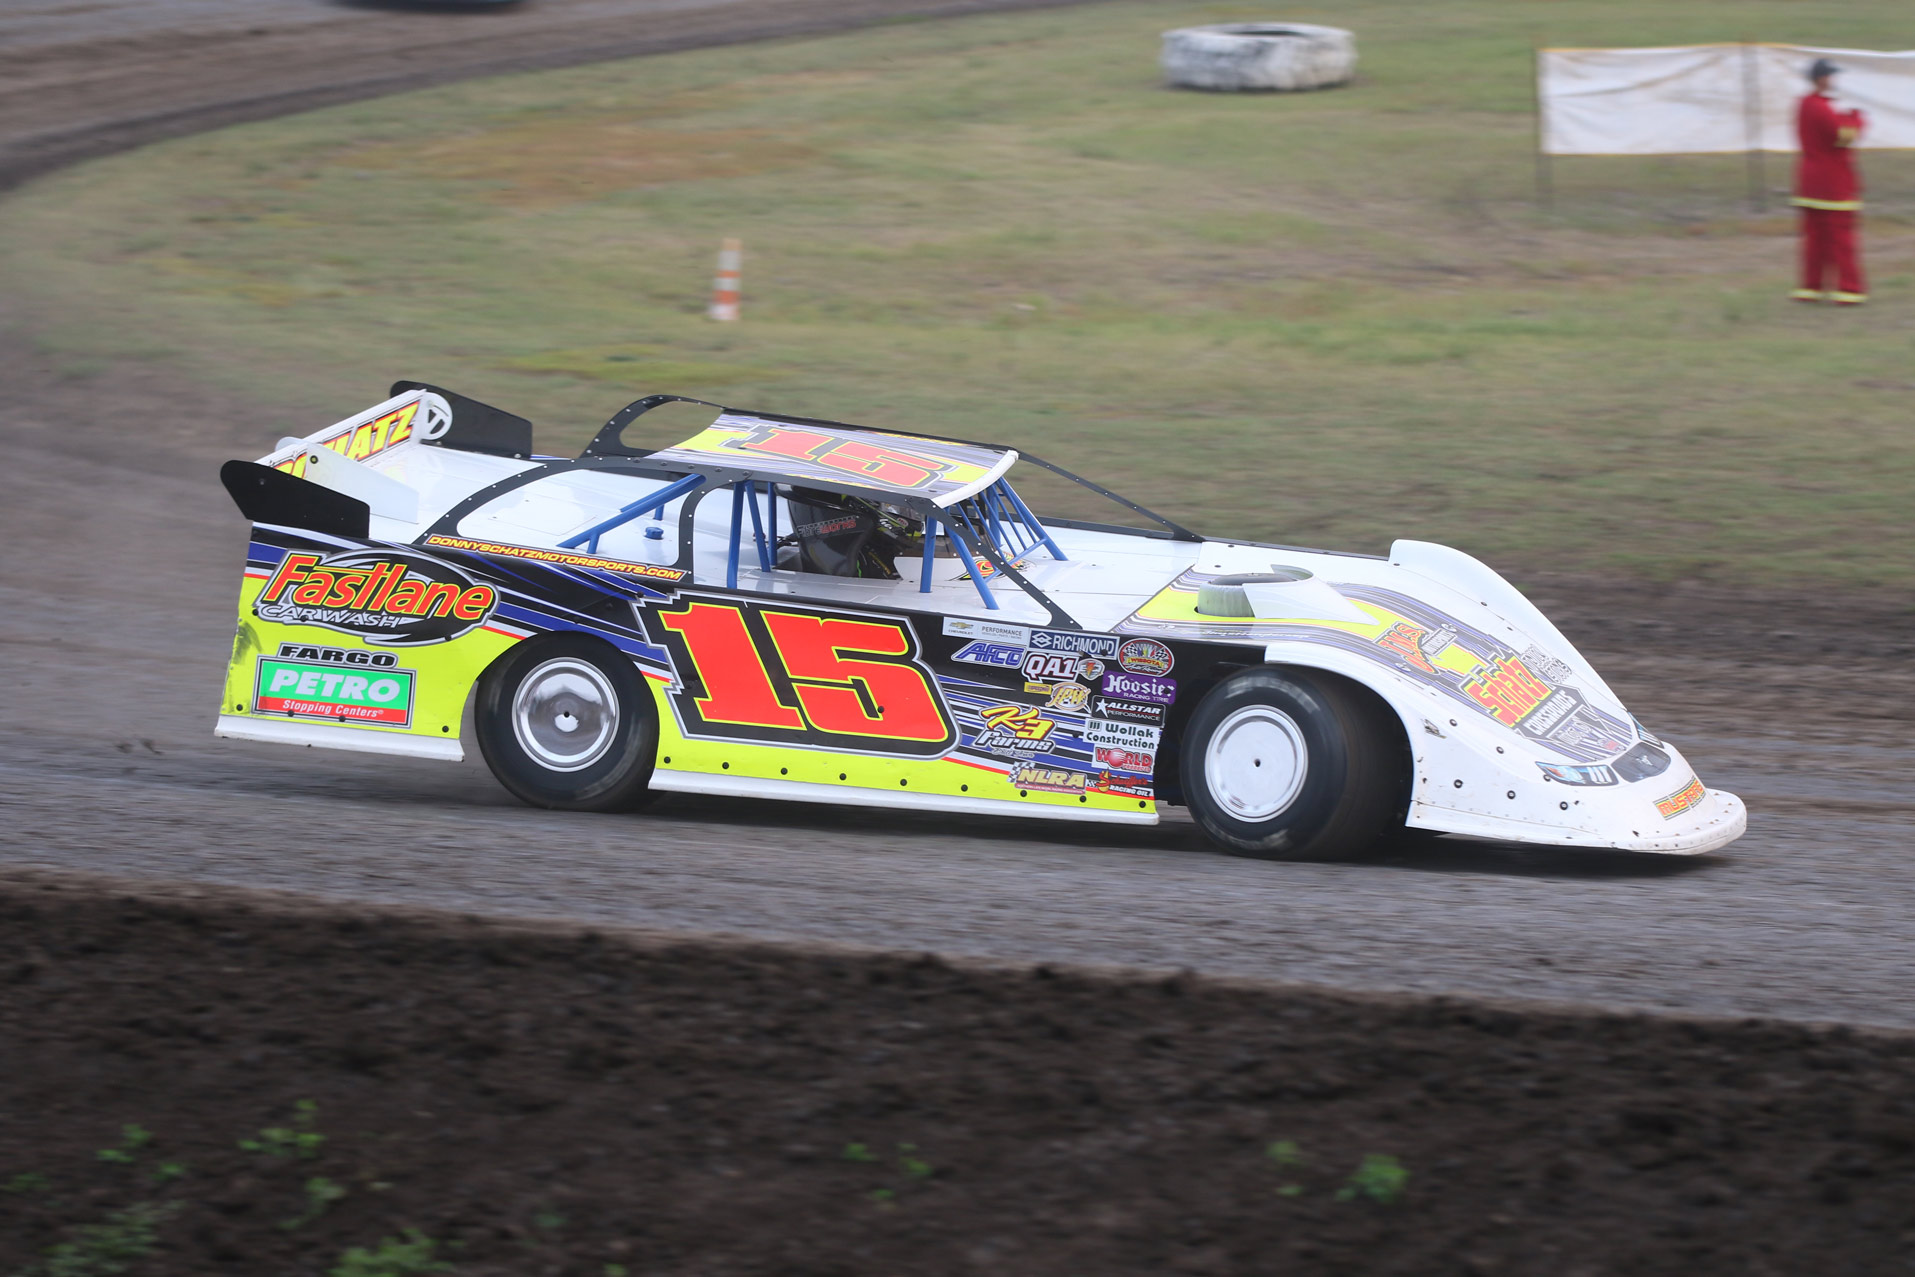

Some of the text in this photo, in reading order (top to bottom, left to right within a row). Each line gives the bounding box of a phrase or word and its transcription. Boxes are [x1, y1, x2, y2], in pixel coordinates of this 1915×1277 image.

[741, 428, 944, 487] 15
[428, 536, 683, 580] DONNYSCHATZMOTORSPORTS.COM
[263, 553, 493, 620] Fastlane
[982, 626, 1022, 636] PERFORMANCE
[955, 643, 1025, 666] AFCO
[1053, 635, 1115, 655] RICHMOND
[280, 645, 397, 667] FARGO
[657, 602, 948, 742] 15
[1026, 655, 1075, 679] QA1
[269, 669, 400, 703] PETRO
[1123, 692, 1169, 703] RACING TIRE
[282, 700, 332, 716] Stopping
[1107, 702, 1161, 714] ALLSTAR
[1107, 709, 1160, 721] PERFORMANCE
[980, 706, 1055, 740] K3
[1105, 723, 1154, 738] Wollak
[1086, 732, 1155, 749] Construction
[1095, 747, 1153, 768] WORLD
[1017, 768, 1085, 788] NLRA
[1109, 784, 1151, 797] RACING OIL
